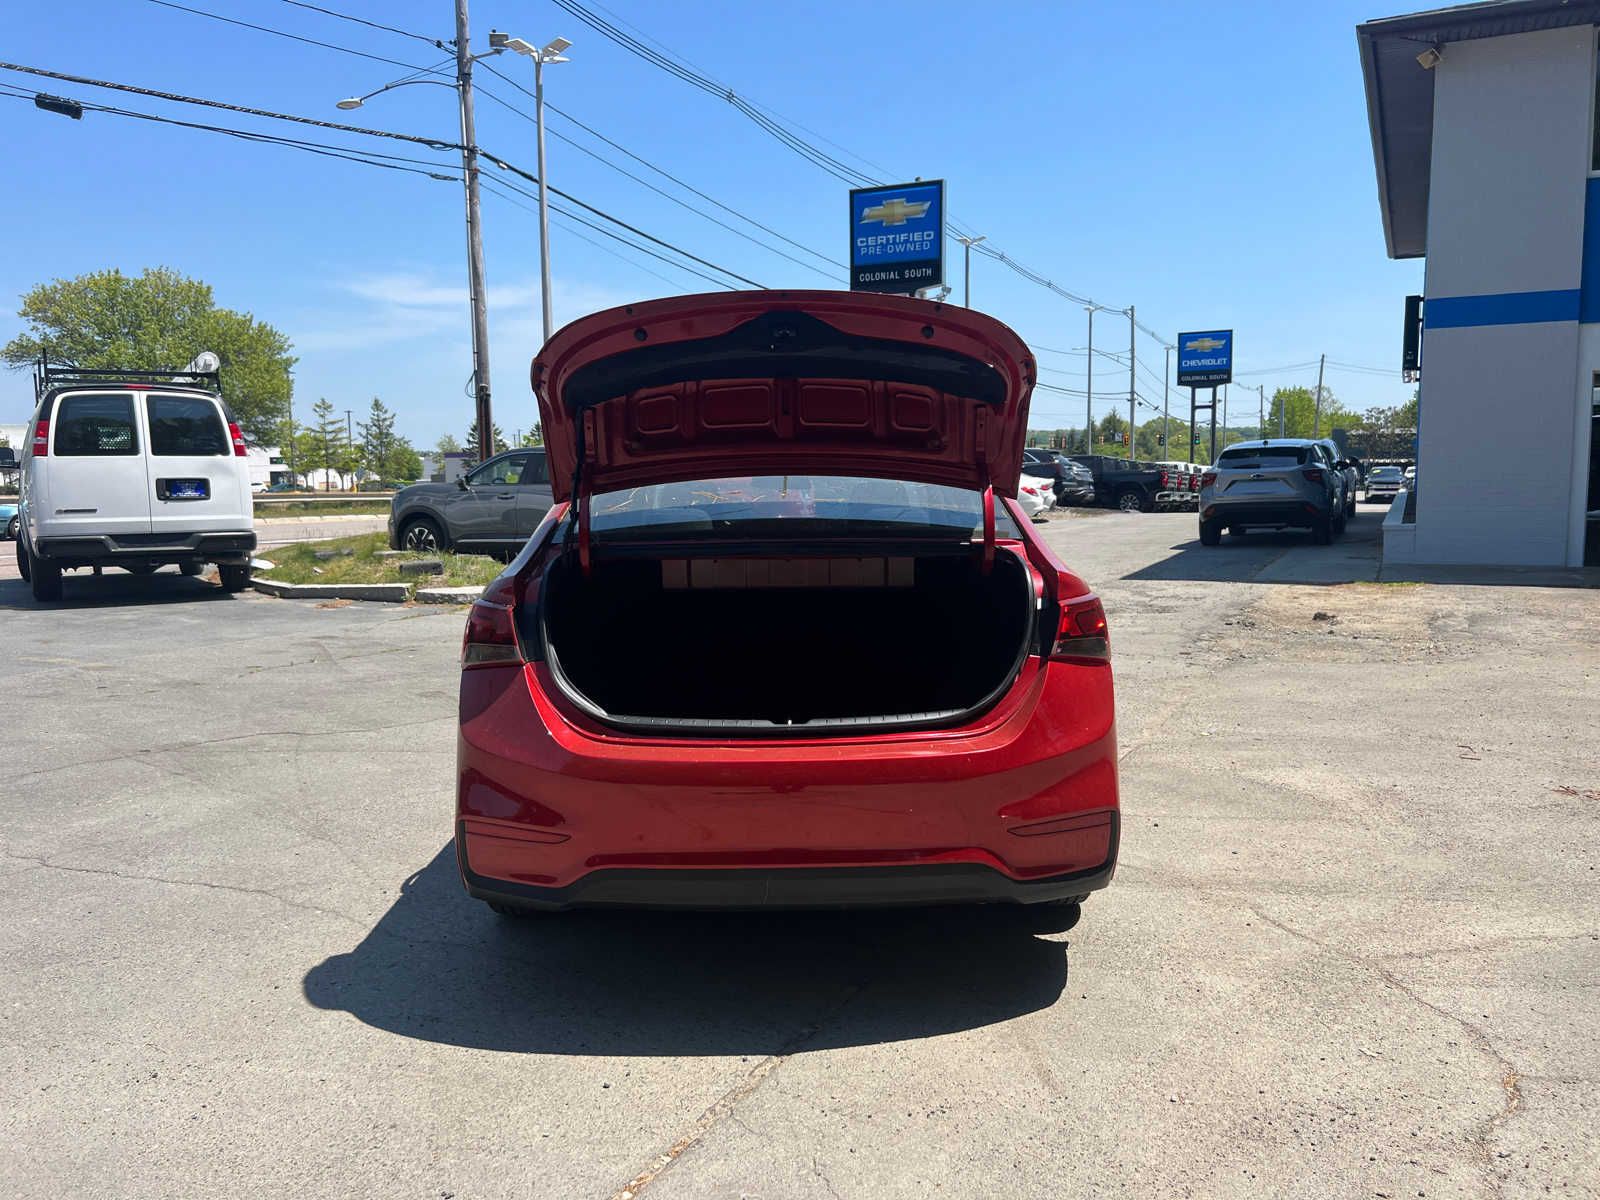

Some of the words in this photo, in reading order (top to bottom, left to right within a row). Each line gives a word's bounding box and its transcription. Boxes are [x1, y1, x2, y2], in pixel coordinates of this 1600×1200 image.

[857, 231, 934, 247] CERTIFIED
[861, 241, 930, 255] PRE-OWNED
[859, 271, 899, 282] COLONIAL
[904, 268, 932, 278] SOUTH
[1182, 358, 1227, 367] CHEVROLET
